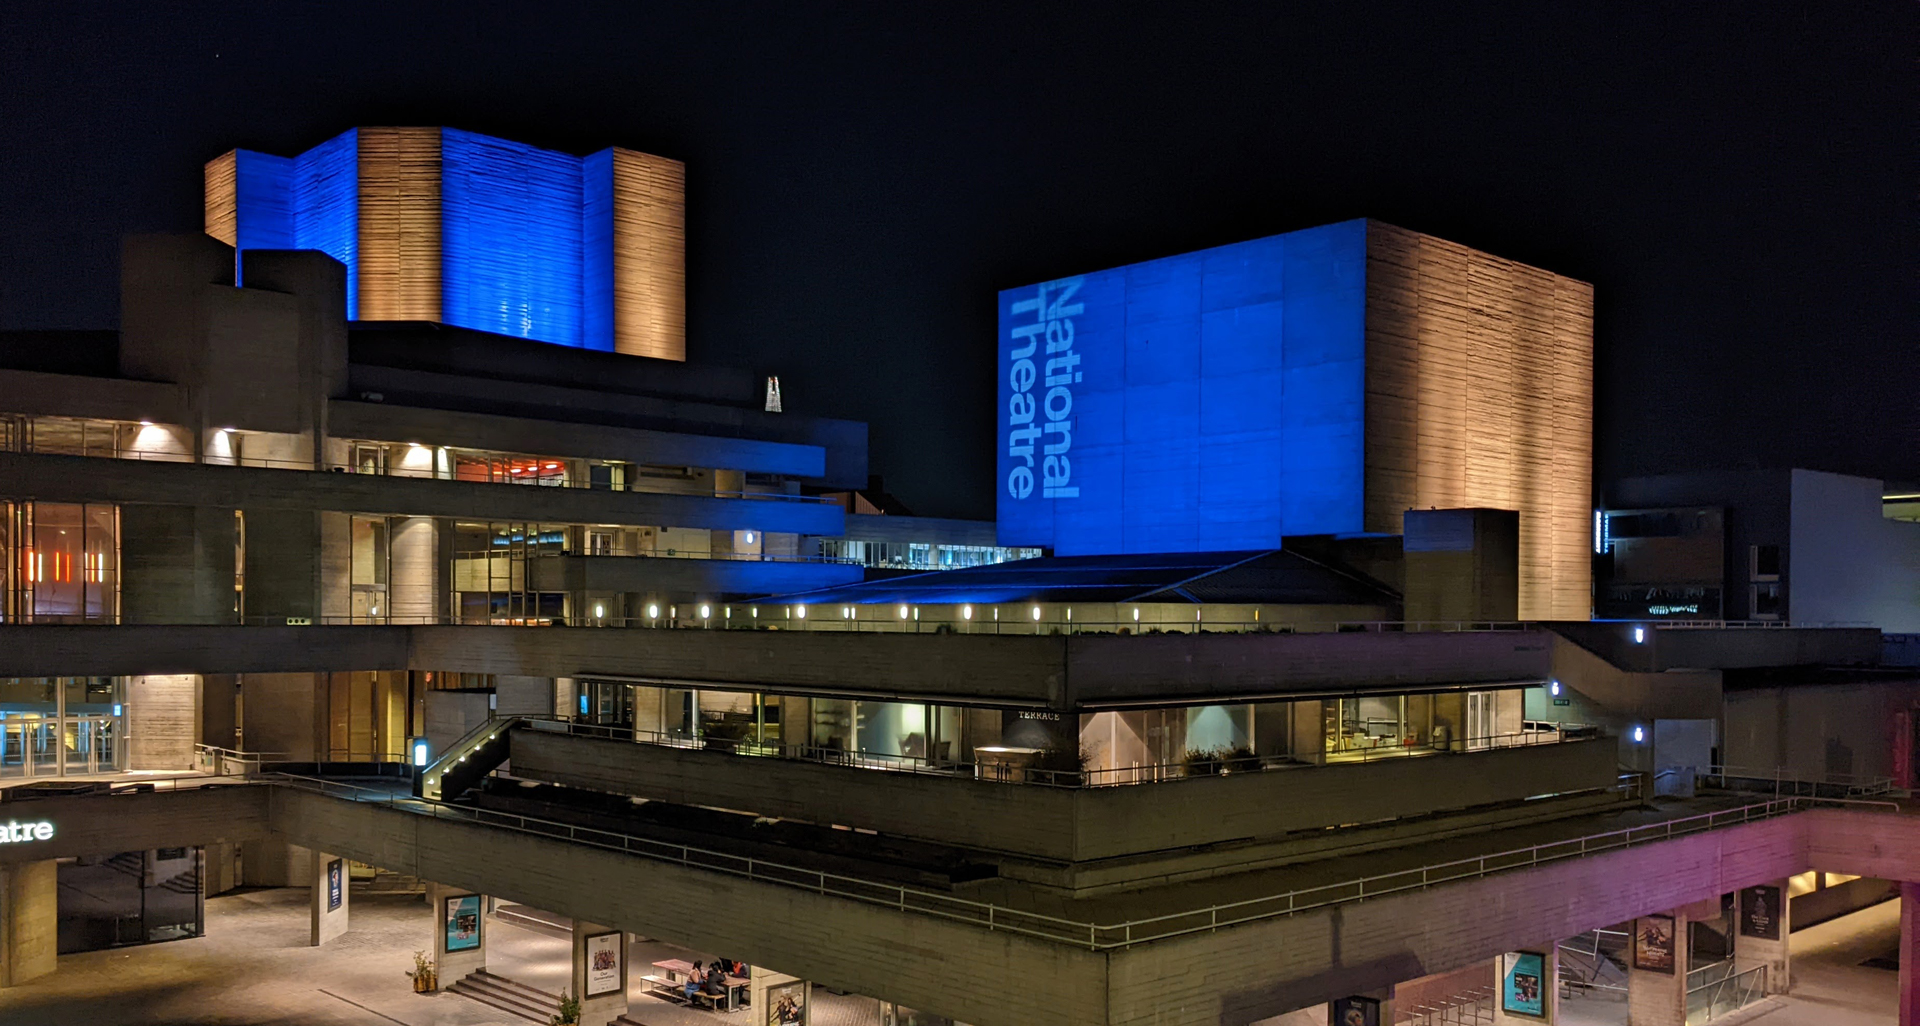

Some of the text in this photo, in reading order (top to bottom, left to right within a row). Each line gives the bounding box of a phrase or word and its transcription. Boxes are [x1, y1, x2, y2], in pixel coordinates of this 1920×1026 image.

[1008, 281, 1048, 500] Theatre
[1043, 275, 1085, 498] National
[1018, 710, 1060, 721] TERRACE
[0, 820, 54, 843] atre
